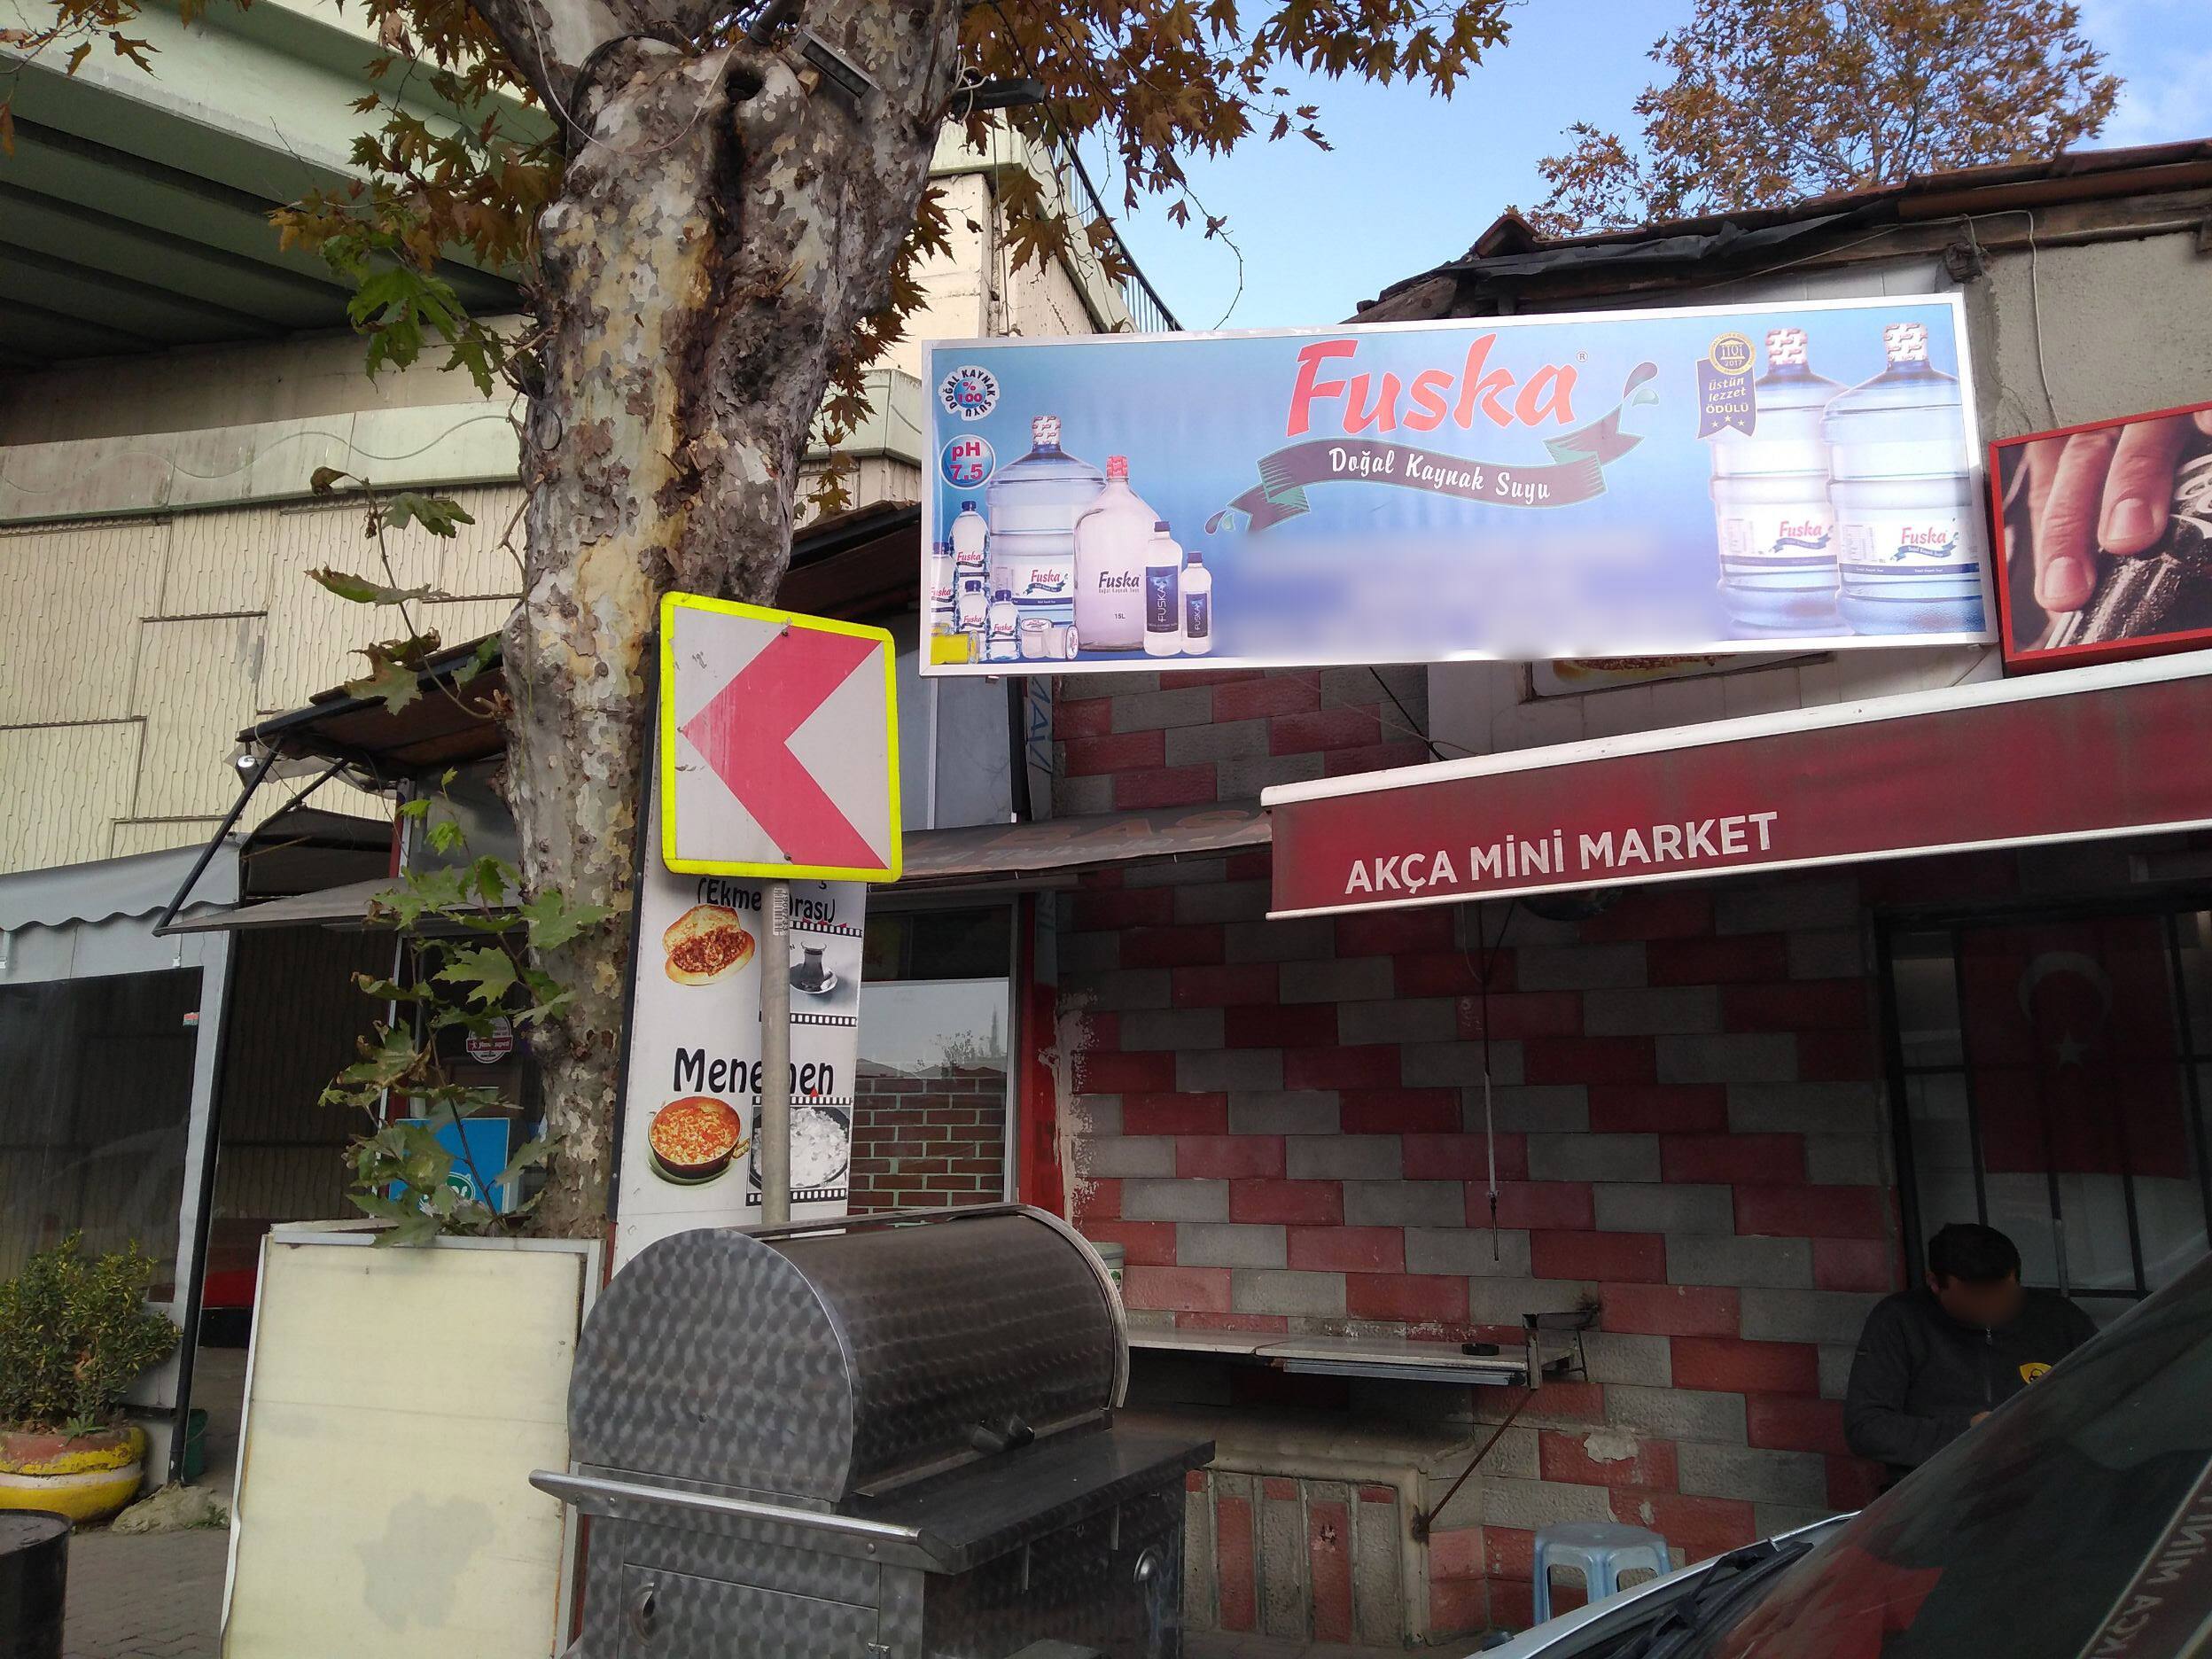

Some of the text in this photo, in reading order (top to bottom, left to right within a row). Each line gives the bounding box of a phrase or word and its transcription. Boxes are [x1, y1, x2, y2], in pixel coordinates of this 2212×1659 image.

[943, 370, 995, 417] DOĞAL KAYNAK SUYU
[1287, 333, 1578, 437] Fuska
[1709, 378, 1744, 391] üstün
[958, 393, 983, 403] 100
[1709, 387, 1746, 402] lezzet
[1706, 402, 1749, 414] ÖDÜLÜ
[952, 442, 980, 461] pH
[950, 463, 983, 480] 7.5
[1329, 447, 1551, 505] Doğal Kaynak Suyu
[1780, 520, 1822, 538] Fuska
[1901, 526, 1946, 545] Fuska
[957, 551, 982, 562] Fuska
[1031, 569, 1061, 582] Fuska
[1099, 571, 1140, 588] Fuska
[1157, 580, 1167, 623] FUSKA
[1344, 811, 1778, 895] AKÇA MİNİ MARKET
[697, 877, 763, 911] (Ekme
[674, 1048, 834, 1095] Meneen
